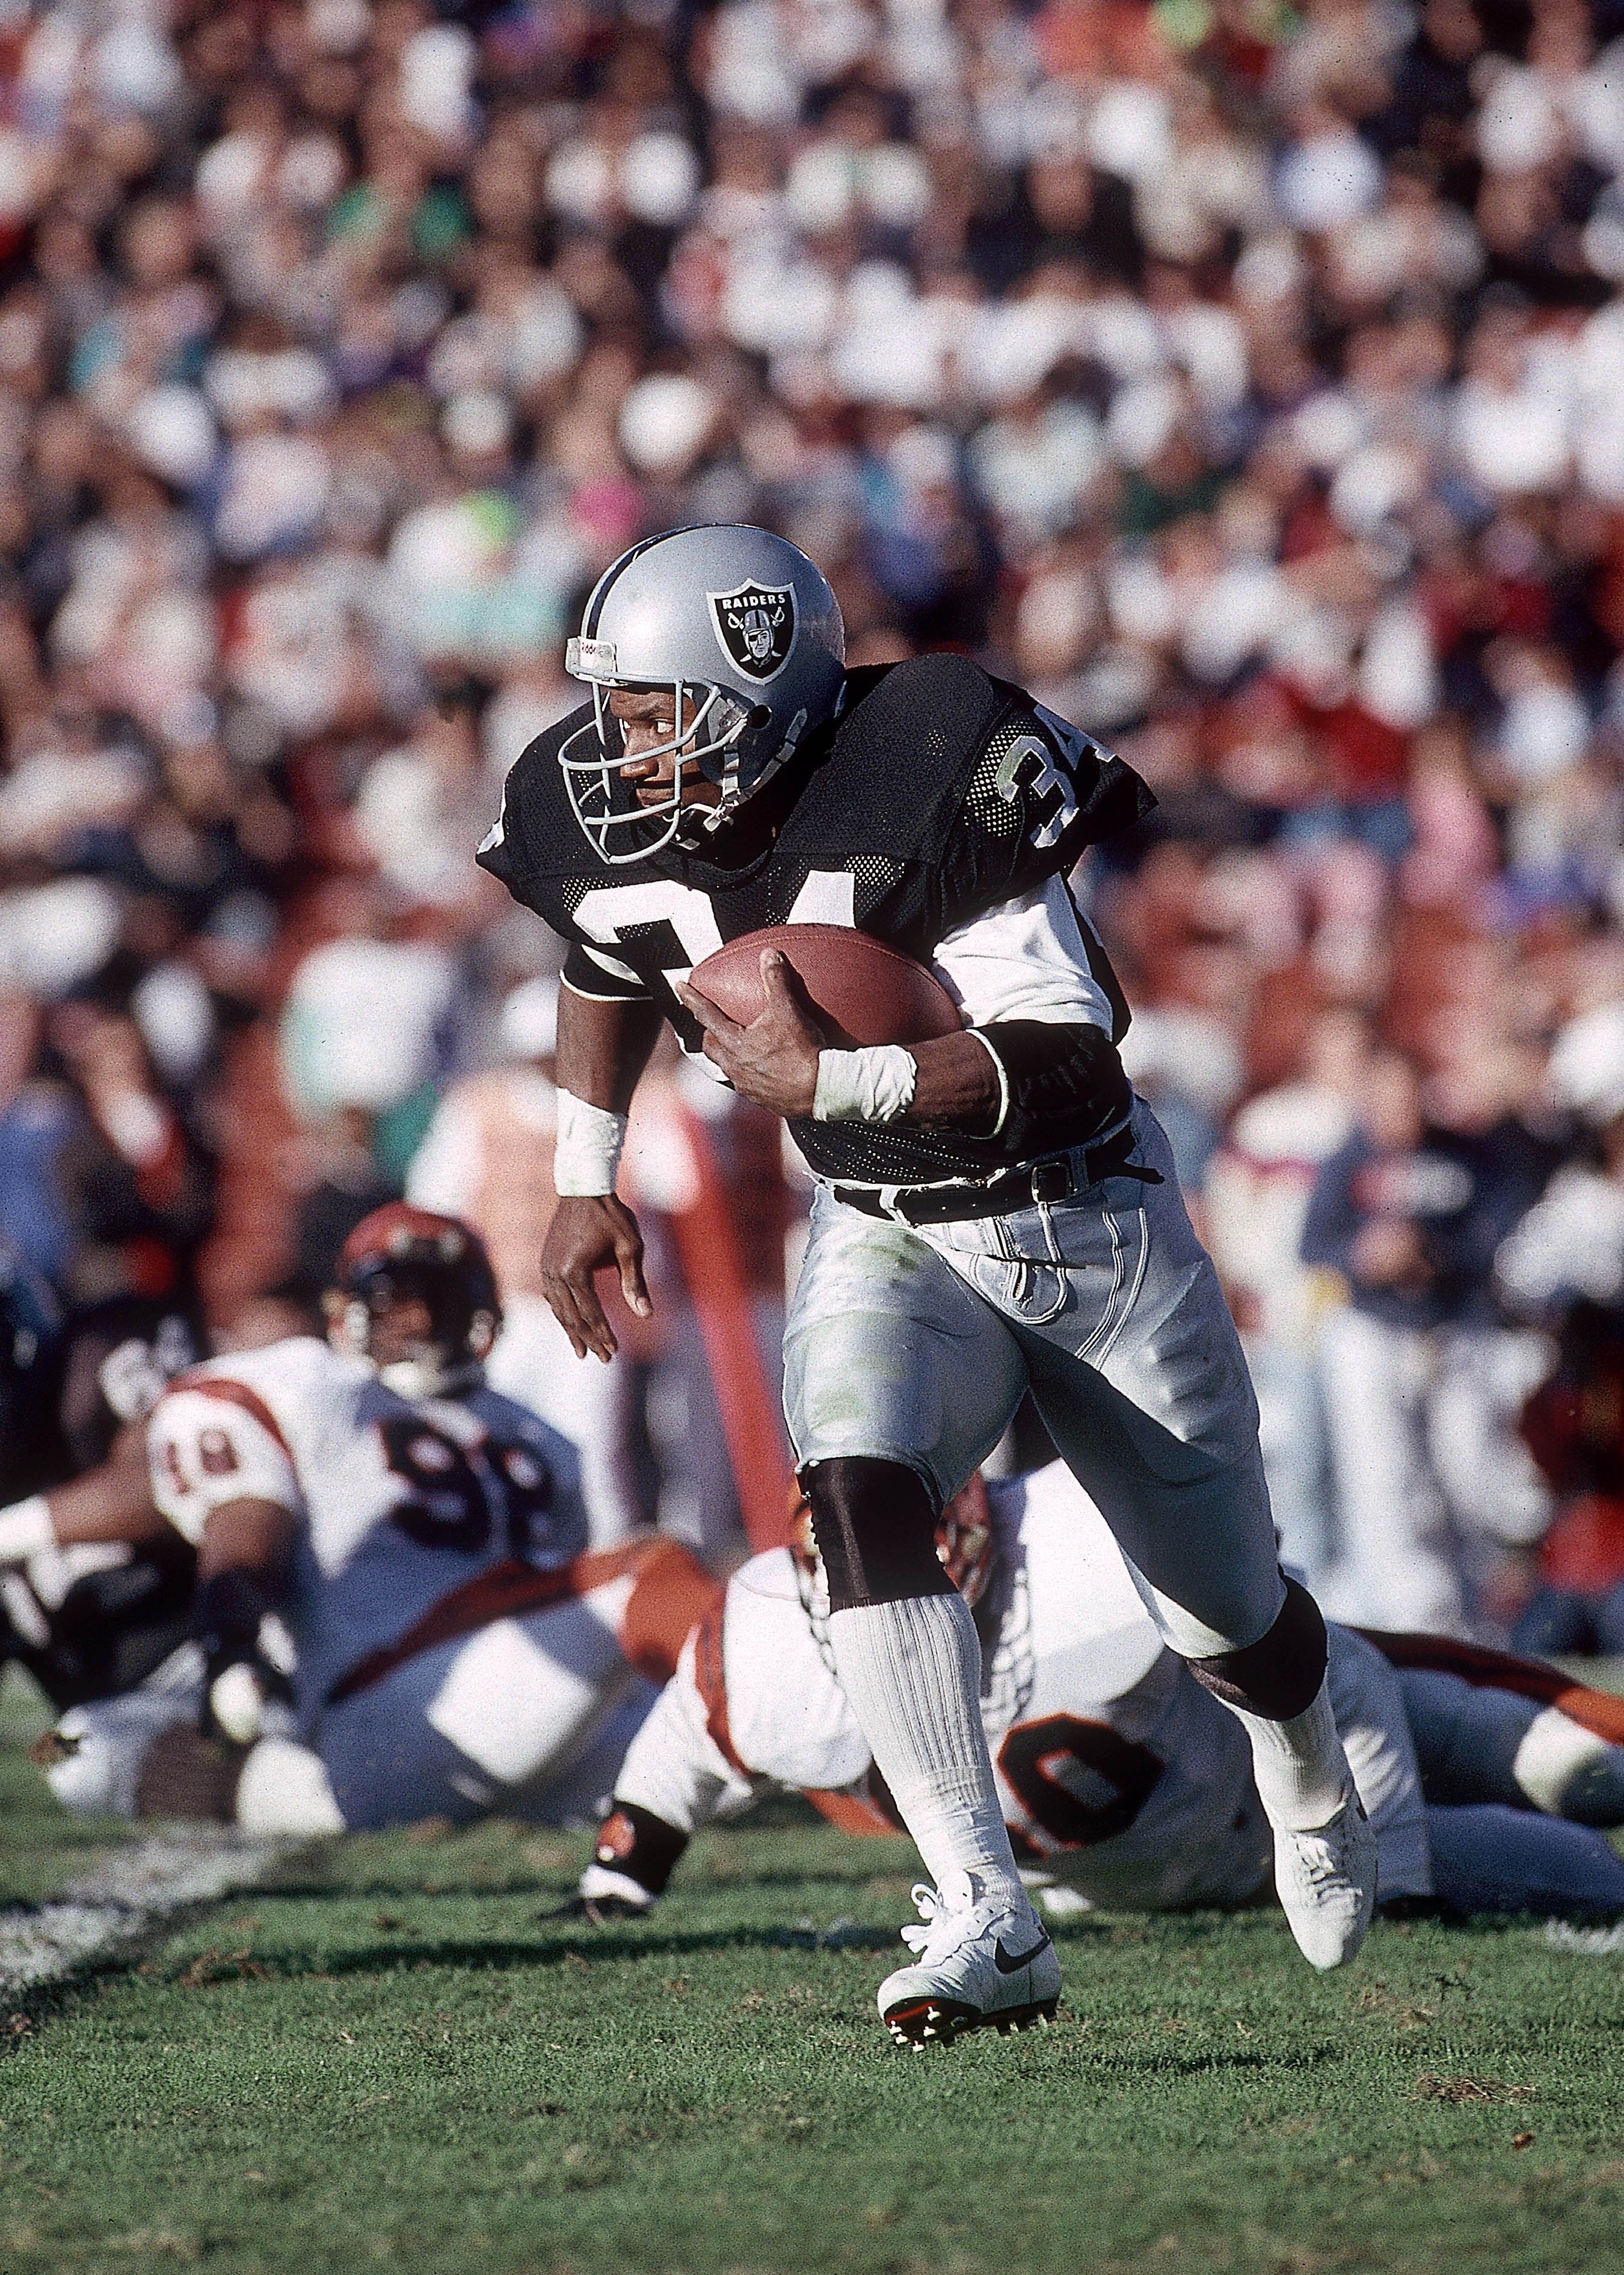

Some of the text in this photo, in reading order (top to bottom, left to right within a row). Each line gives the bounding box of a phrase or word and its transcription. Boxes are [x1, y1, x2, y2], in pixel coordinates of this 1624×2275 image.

[722, 594, 786, 610] RAIDERS
[375, 1415, 577, 1563] 98
[997, 1712, 1166, 1859] 0
